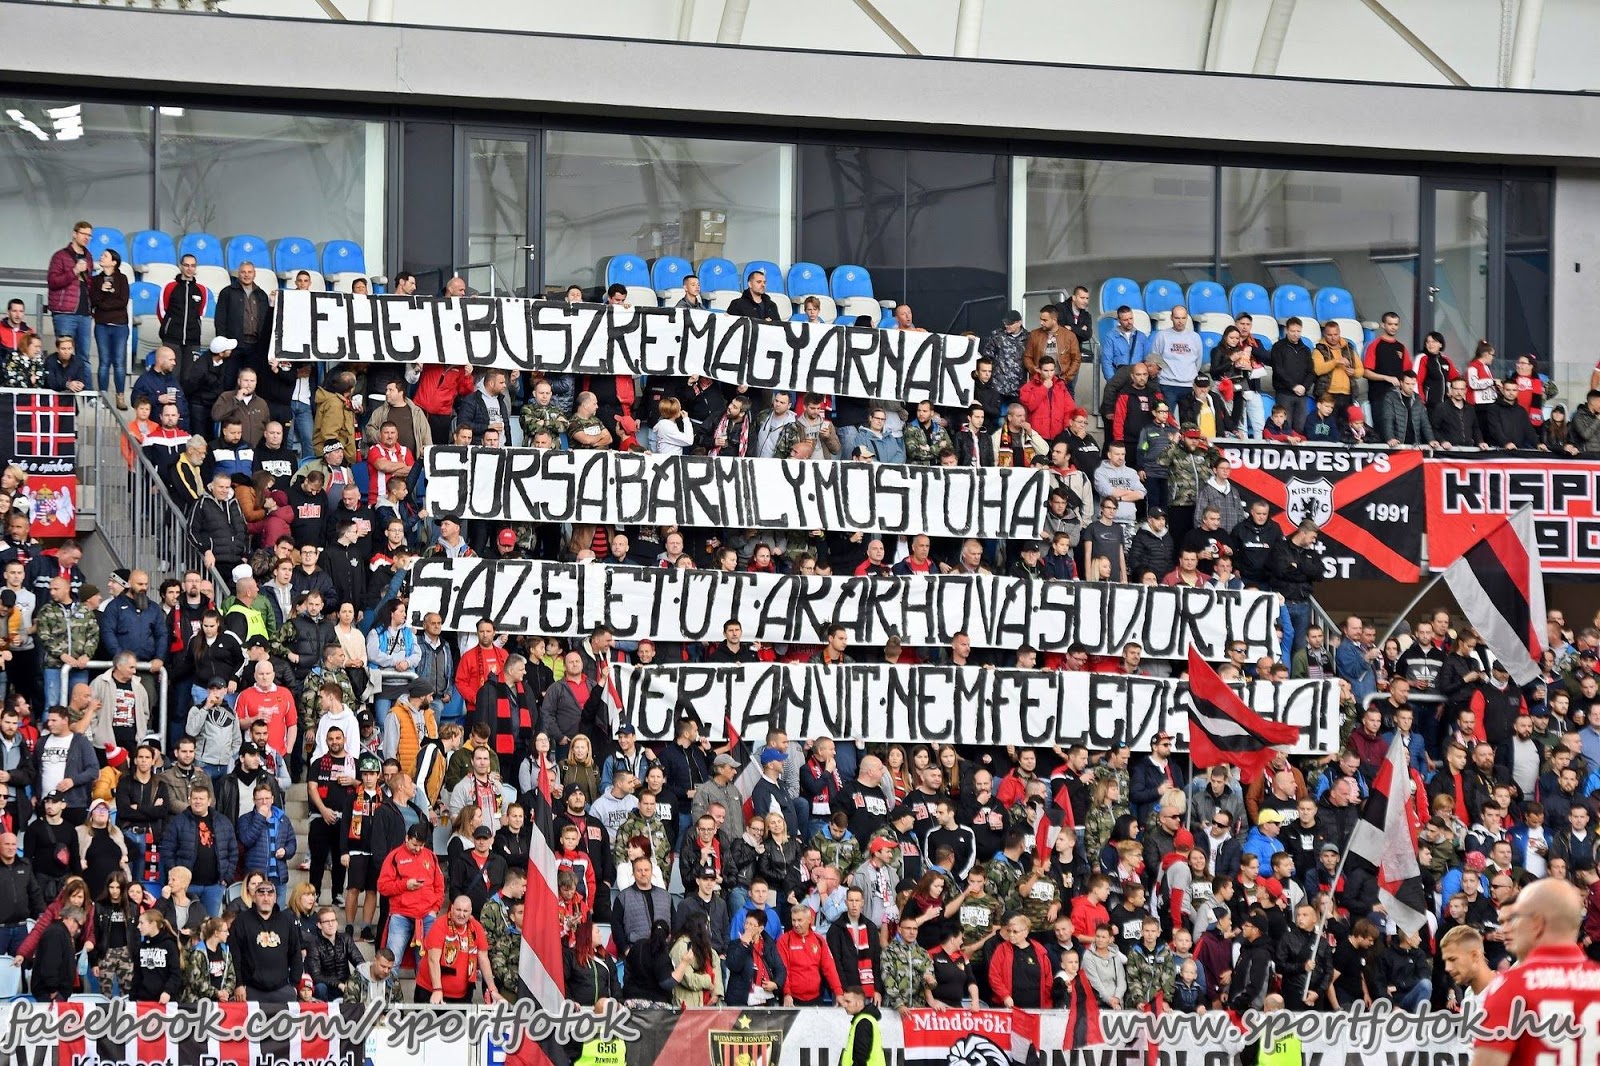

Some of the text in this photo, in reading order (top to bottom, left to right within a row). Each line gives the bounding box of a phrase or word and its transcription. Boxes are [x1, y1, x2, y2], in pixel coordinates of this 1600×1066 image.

[274, 290, 450, 362] LEHET
[1224, 448, 1391, 473] BUDAPEST'S
[429, 445, 608, 521] SORSA
[812, 461, 1045, 539] MOSTOHA
[1291, 487, 1329, 495] KISPEST
[1290, 503, 1329, 513] A C
[1365, 502, 1409, 522] 1991
[1320, 557, 1356, 579] ST
[885, 665, 989, 744] NEM
[597, 1042, 617, 1054] 658
[713, 1034, 743, 1042] BUDAPEST
